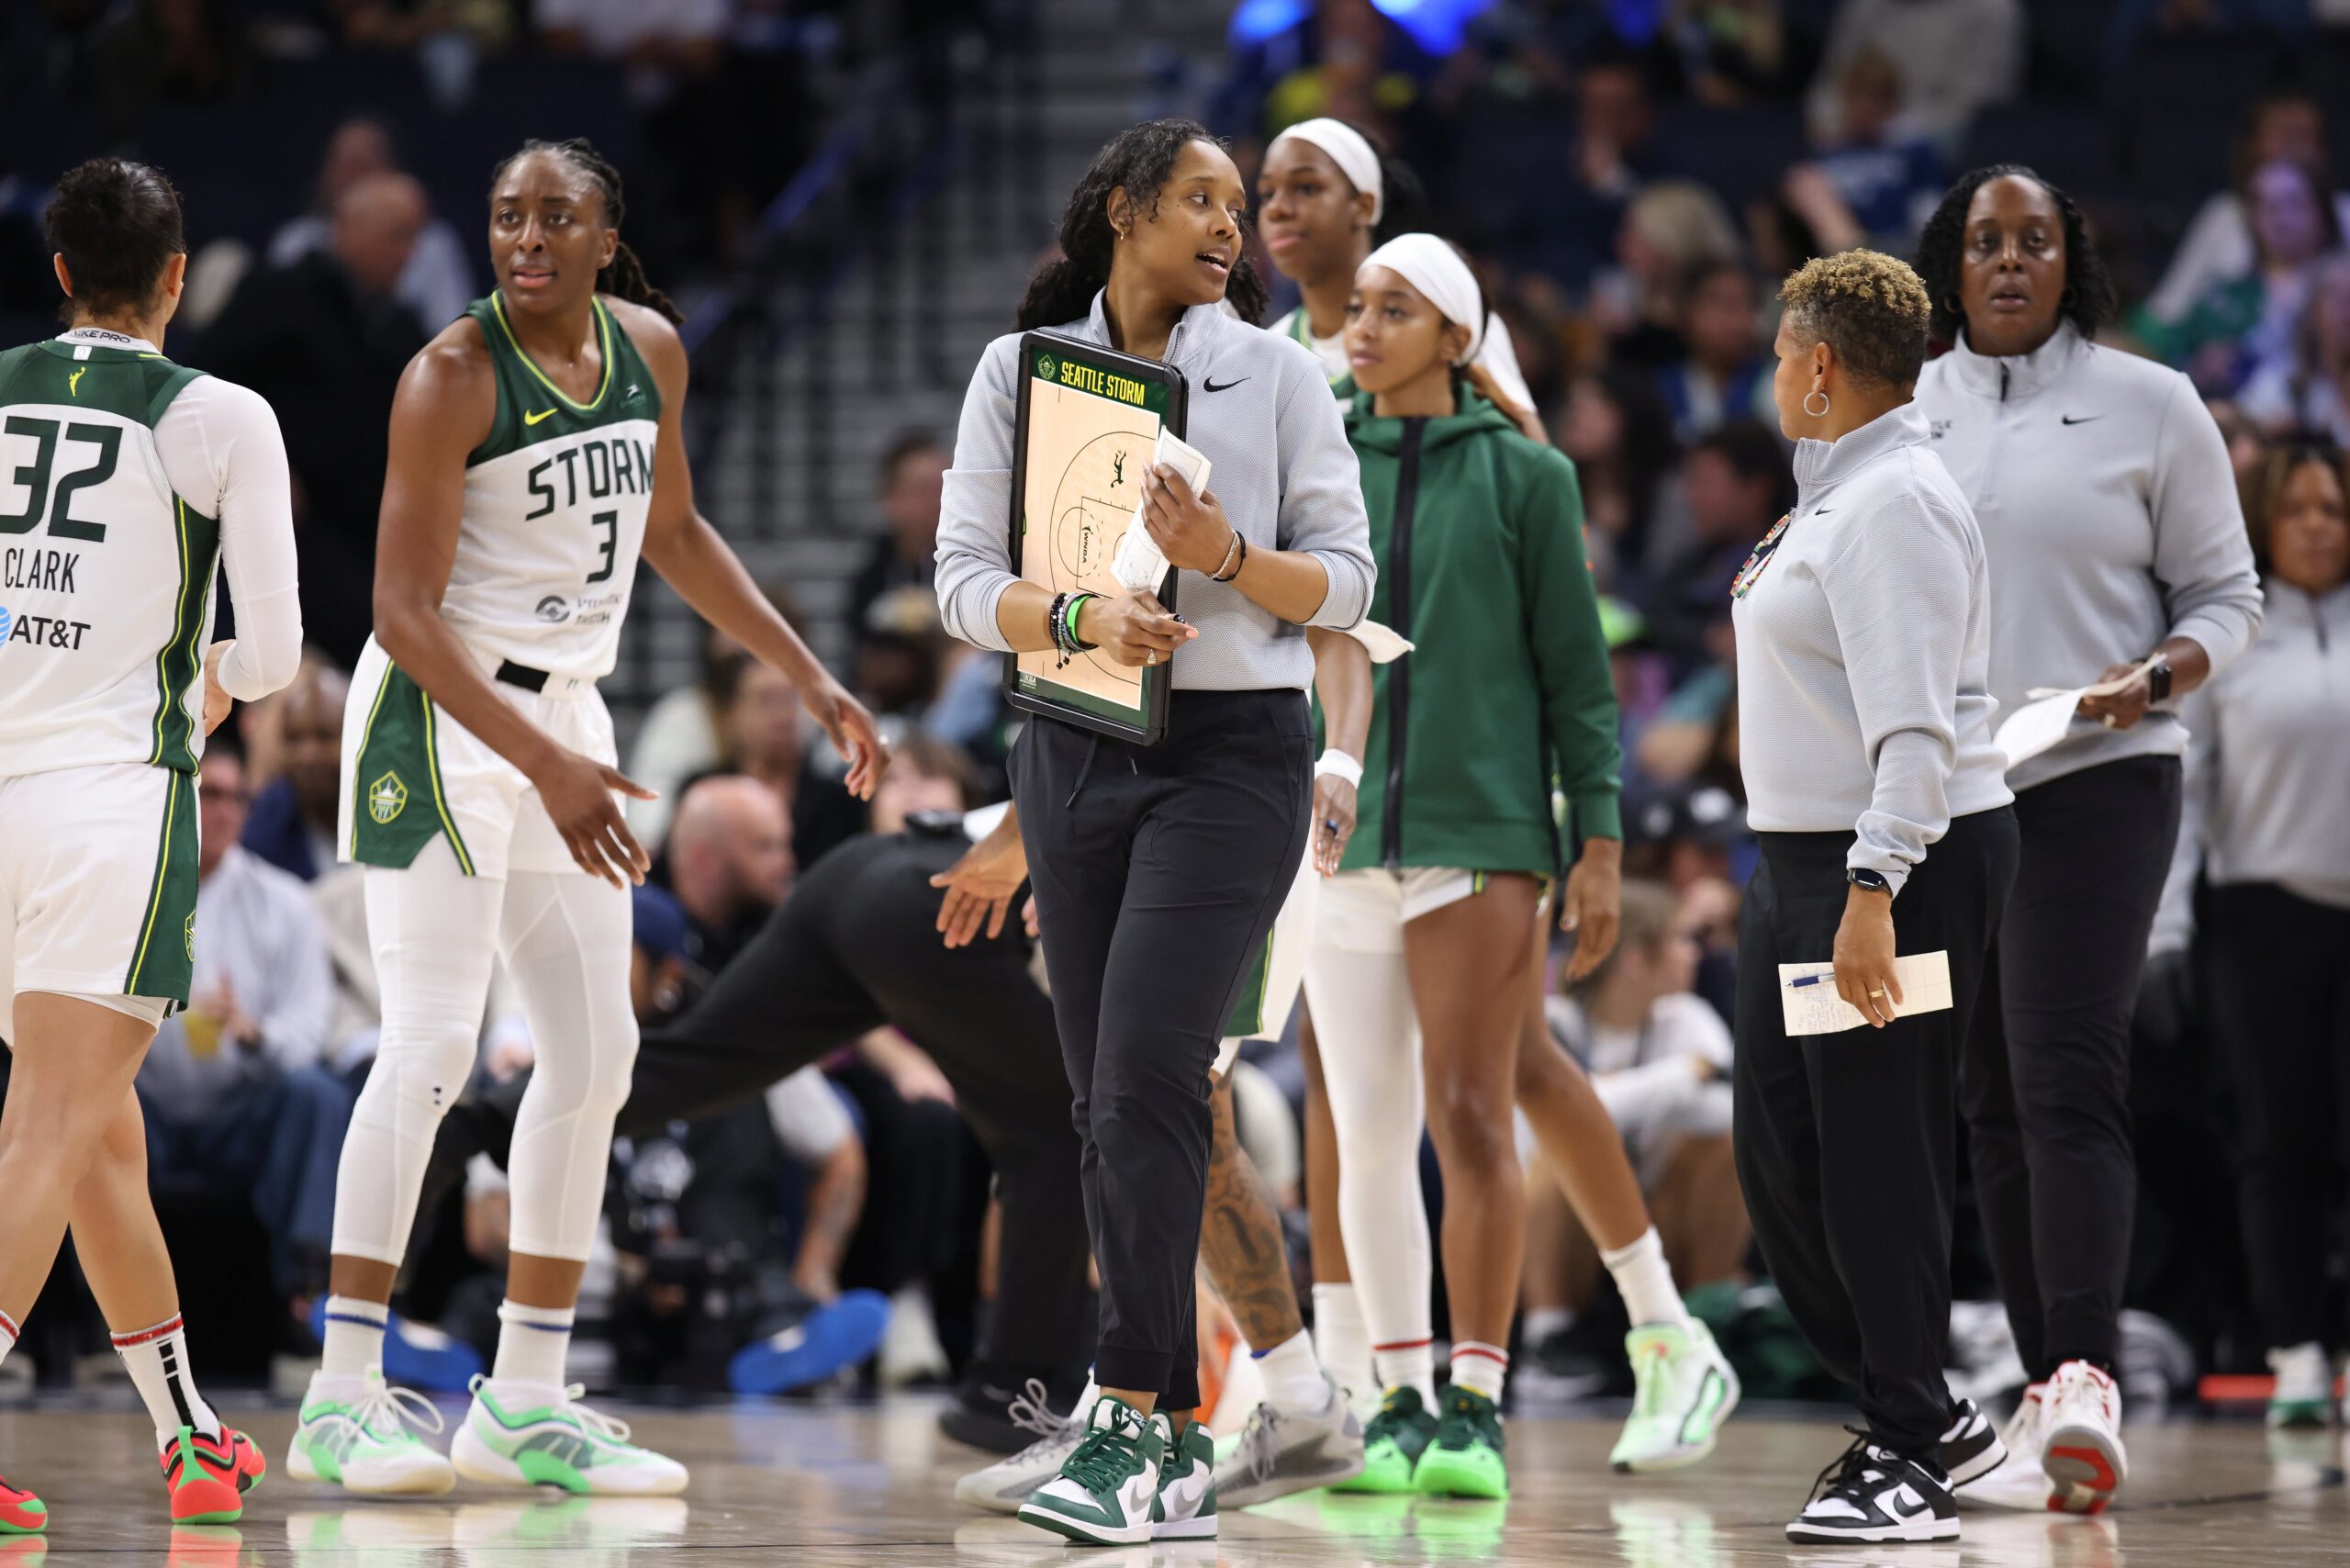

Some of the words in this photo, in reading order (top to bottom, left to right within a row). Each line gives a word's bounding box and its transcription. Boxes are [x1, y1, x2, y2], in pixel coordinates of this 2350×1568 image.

[100, 331, 130, 343] PRO
[1060, 361, 1104, 394] SEATTLE
[1106, 372, 1145, 406] STORM
[0, 416, 123, 543] 32
[586, 510, 618, 584] 3
[5, 548, 80, 593] CLARK
[9, 614, 91, 650] AT&T
